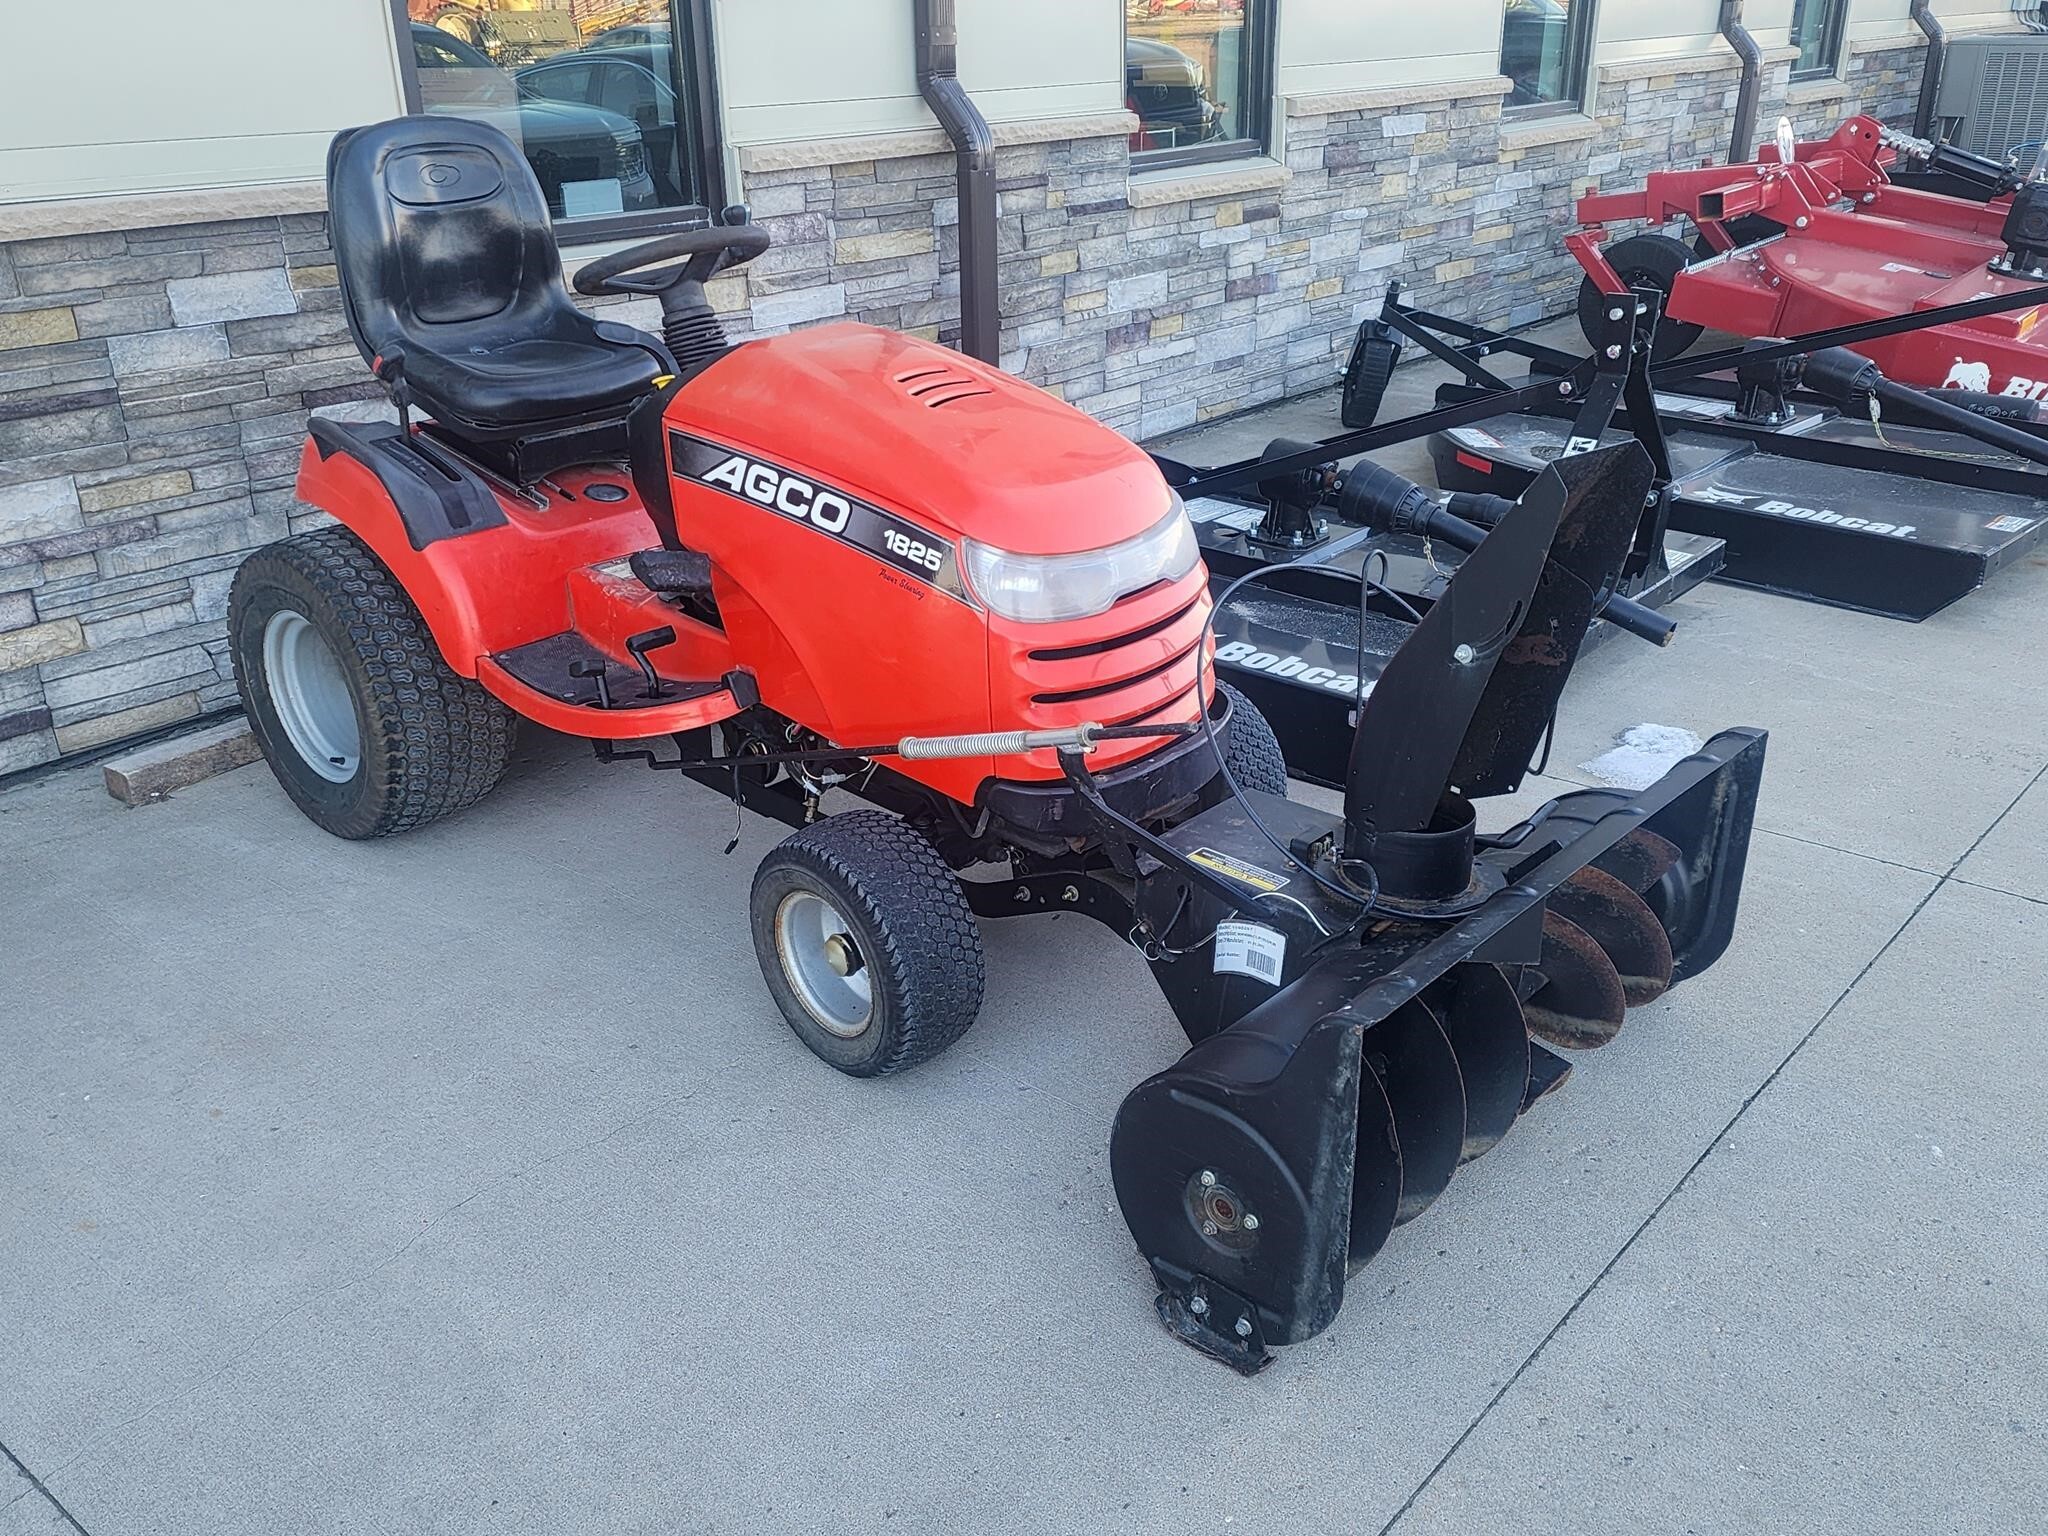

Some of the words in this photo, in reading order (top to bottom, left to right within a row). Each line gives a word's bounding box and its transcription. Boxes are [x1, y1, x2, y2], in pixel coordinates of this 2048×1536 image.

[701, 456, 851, 534] AGCO
[883, 530, 943, 571] 1825
[879, 567, 898, 585] Power
[899, 578, 925, 601] Steering
